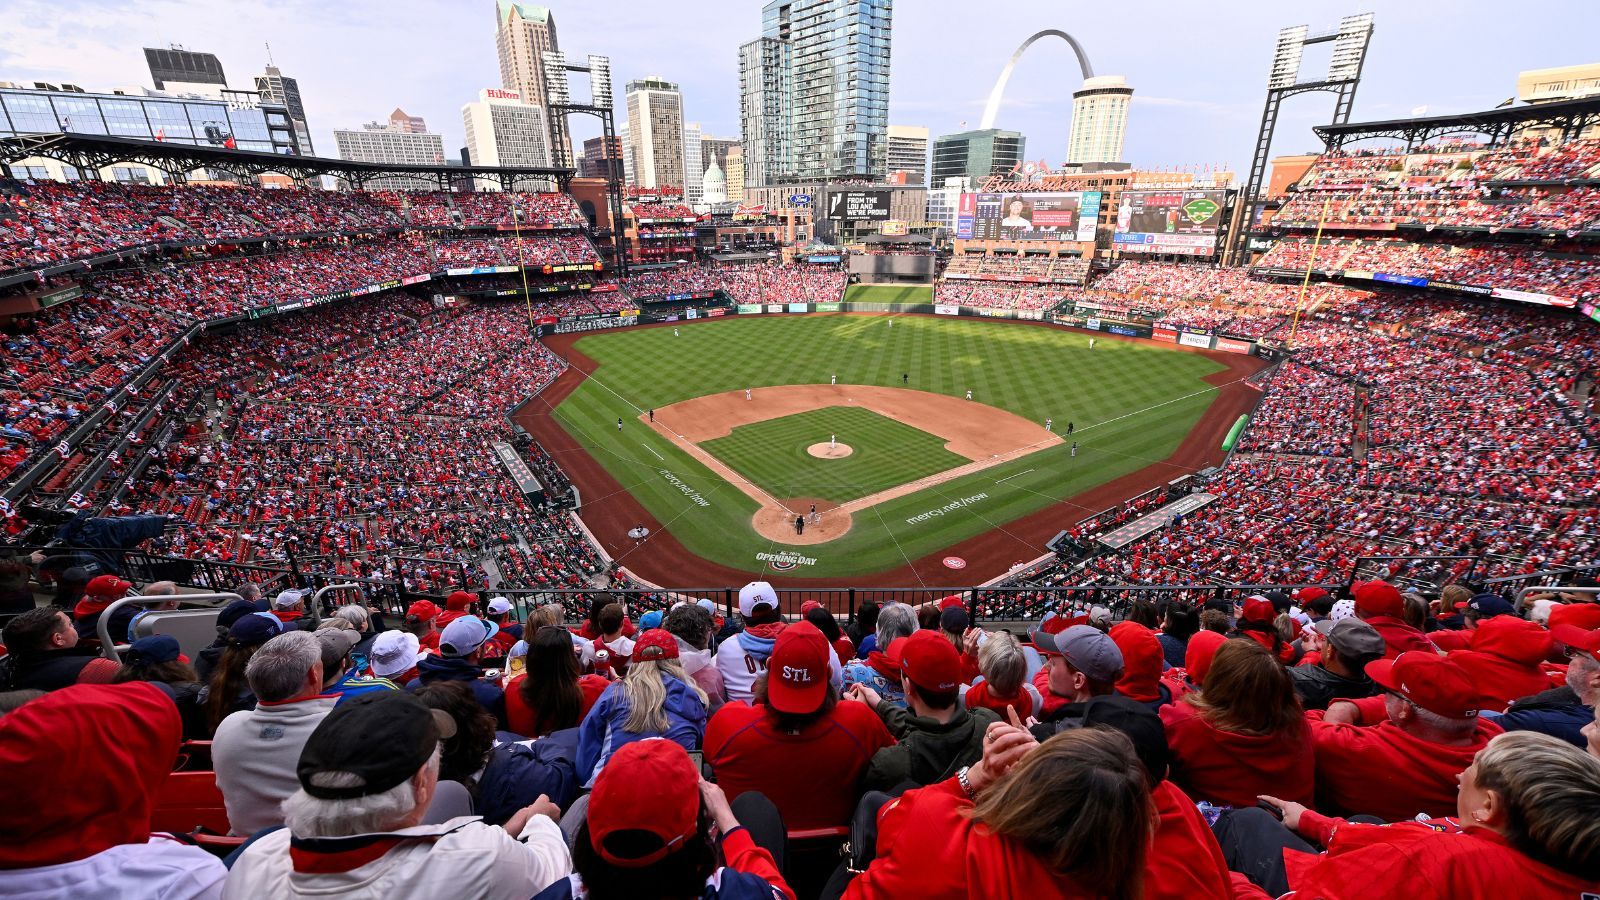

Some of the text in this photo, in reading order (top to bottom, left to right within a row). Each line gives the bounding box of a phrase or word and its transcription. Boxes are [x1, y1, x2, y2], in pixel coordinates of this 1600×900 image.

[487, 89, 520, 99] Hilton
[227, 101, 260, 112] pwc
[977, 175, 1085, 192] Budweiser
[906, 492, 988, 525] mercy.net/now
[756, 552, 817, 566] OPENING DAY
[783, 665, 811, 682] STL
